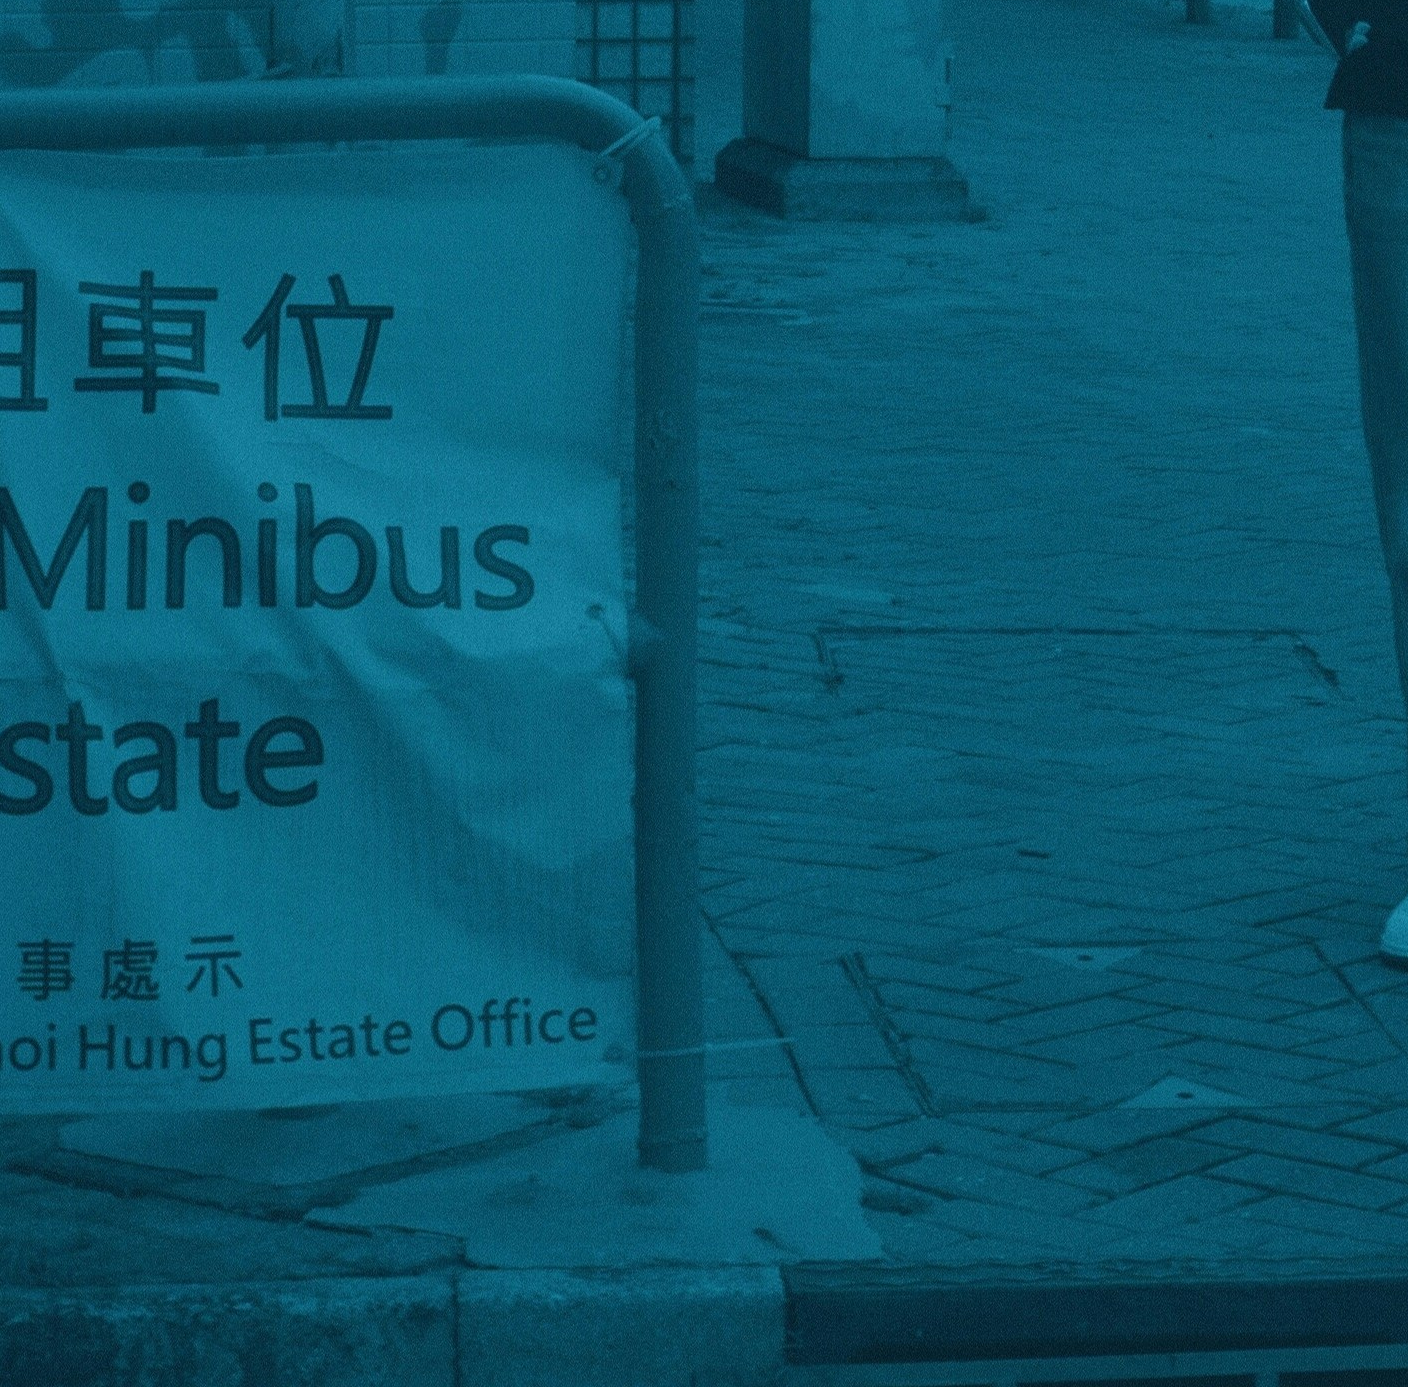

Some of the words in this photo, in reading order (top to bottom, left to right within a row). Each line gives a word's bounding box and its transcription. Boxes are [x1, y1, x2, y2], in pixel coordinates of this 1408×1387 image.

[79, 1024, 226, 1082] Hung
[249, 1016, 411, 1064] Estate
[432, 998, 597, 1051] Office
